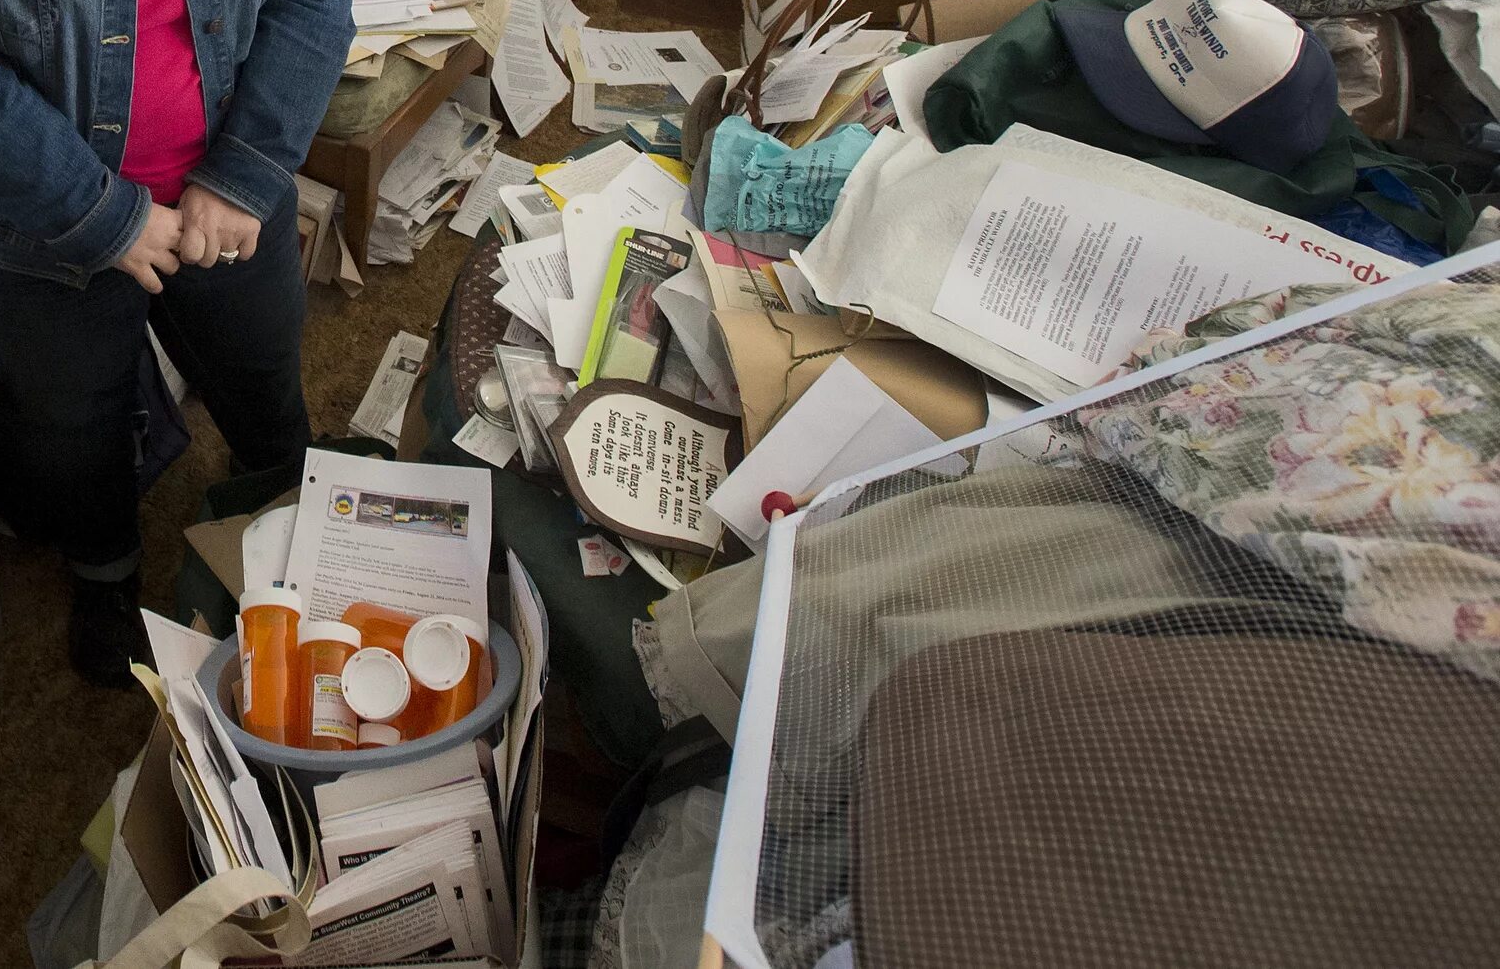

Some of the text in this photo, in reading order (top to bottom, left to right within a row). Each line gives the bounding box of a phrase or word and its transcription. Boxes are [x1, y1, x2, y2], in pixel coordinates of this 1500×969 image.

[1186, 2, 1228, 59] TRADEWINDS
[1146, 19, 1186, 86] Newport, Ore.
[1173, 49, 1194, 73] CHARTER
[625, 241, 664, 260] SHUR-LINE
[967, 210, 996, 269] RAFFLE PRIZES FOR
[973, 208, 1007, 277] THE MIRACLE WORKER
[1140, 296, 1158, 330] Procedures:
[592, 422, 601, 445] even
[608, 409, 621, 434] Some
[621, 417, 633, 437] look
[602, 438, 617, 463] days
[619, 442, 630, 462] like
[632, 423, 646, 457] doesn't
[646, 430, 657, 474] converse.
[687, 430, 704, 472] Although
[629, 463, 641, 499] always
[677, 452, 687, 481] house
[688, 509, 701, 531] find
[343, 856, 360, 866] Who
[320, 916, 358, 935] StageWest
[359, 901, 401, 921] Community
[401, 887, 431, 905] Theatre?
